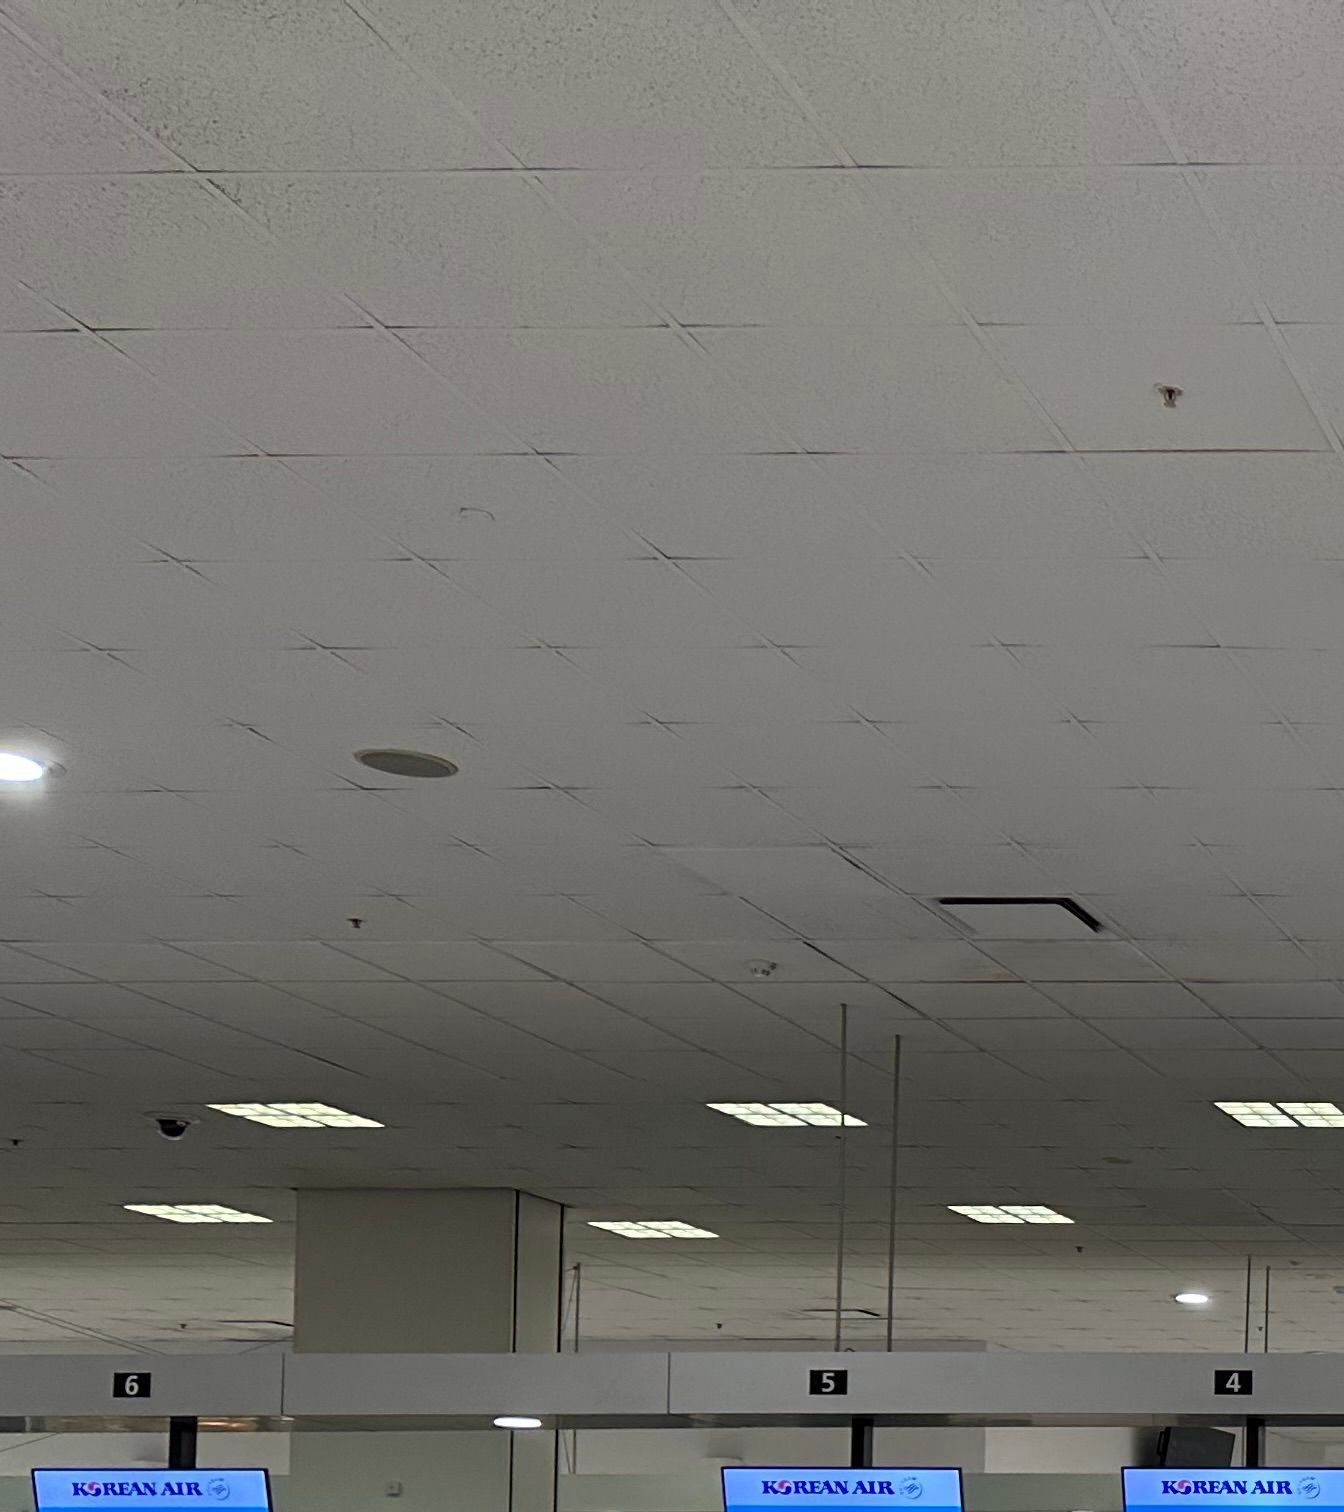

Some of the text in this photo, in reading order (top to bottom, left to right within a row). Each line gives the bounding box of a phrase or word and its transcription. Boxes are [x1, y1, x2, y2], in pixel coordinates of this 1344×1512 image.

[124, 1375, 139, 1396] 6
[821, 1372, 836, 1393] 5
[1225, 1372, 1241, 1393] 4
[71, 1480, 157, 1497] KOREAN
[161, 1481, 203, 1496] AIR
[761, 1479, 849, 1496] KOREAN
[851, 1480, 895, 1495] AIR
[1161, 1479, 1248, 1496] KOREAN
[1250, 1480, 1293, 1495] AIR
